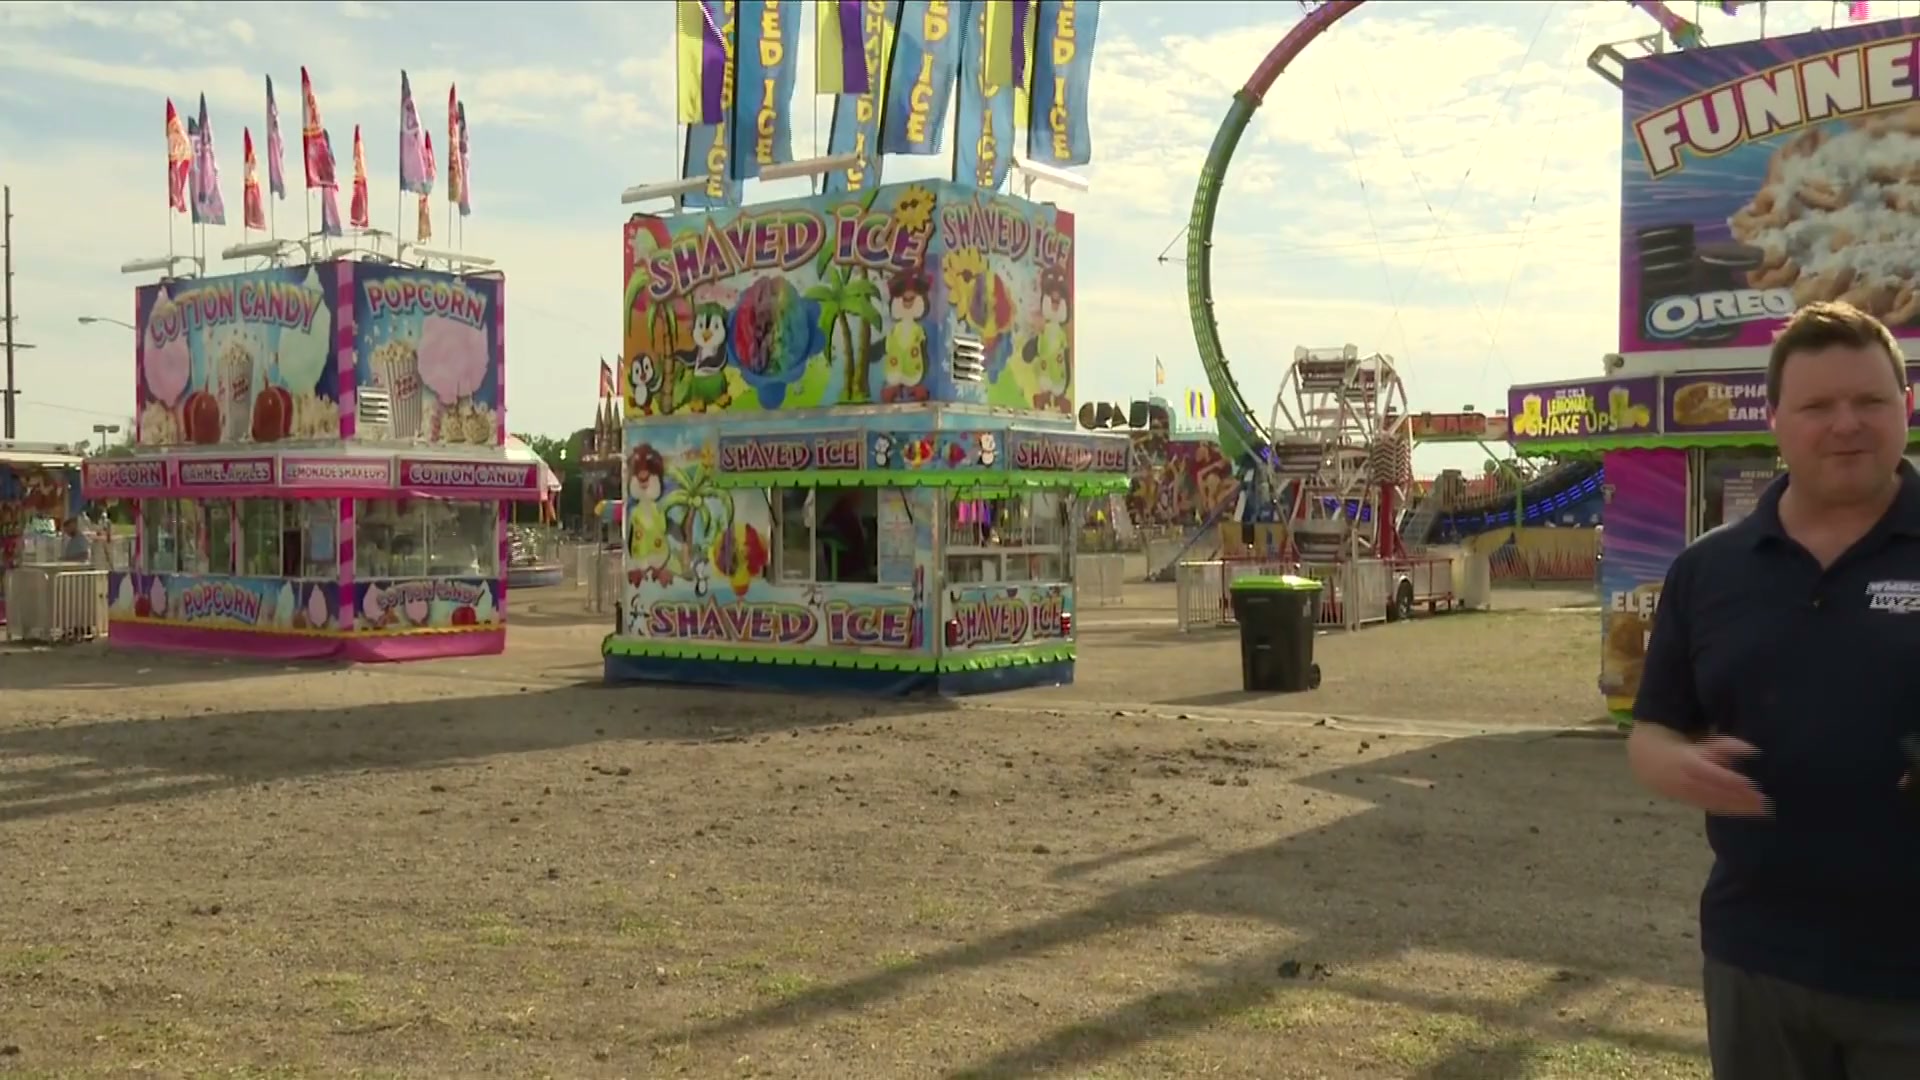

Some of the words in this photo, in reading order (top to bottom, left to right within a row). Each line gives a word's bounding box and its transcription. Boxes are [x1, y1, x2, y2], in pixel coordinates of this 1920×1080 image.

[757, 79, 777, 164] ICE
[907, 53, 933, 143] ICE
[1050, 77, 1070, 160] ICE
[1633, 36, 1919, 177] FUNNE
[706, 122, 727, 198] ICE
[638, 206, 826, 300] SHAVED
[833, 203, 936, 272] ICE
[941, 192, 1031, 262] SHAVED
[1032, 213, 1071, 268] ICE
[149, 279, 238, 346] COTTON
[239, 278, 323, 334] CANDY
[362, 277, 487, 331] POPCORN
[1645, 288, 1797, 339] OREO
[1525, 414, 1581, 436] SHAKE
[1584, 409, 1618, 435] UPS
[1547, 395, 1595, 416] LEMONADE
[1727, 406, 1768, 420] EARS
[87, 463, 162, 488] POPCORN
[286, 464, 336, 479] LEMONADE
[409, 463, 475, 486] COTTON
[476, 465, 526, 488] CANDY
[722, 440, 812, 473] SHAVED
[815, 442, 857, 469] ICE
[1015, 441, 1092, 472] SHAVED
[1097, 447, 1126, 469] ICE
[183, 582, 263, 624] POPCORN
[376, 580, 434, 609] COTTON
[435, 579, 484, 606] CANDY
[648, 596, 818, 643] SHAVED
[824, 600, 914, 648] ICE
[954, 601, 1028, 647] SHAVED
[1031, 599, 1063, 637] ICE
